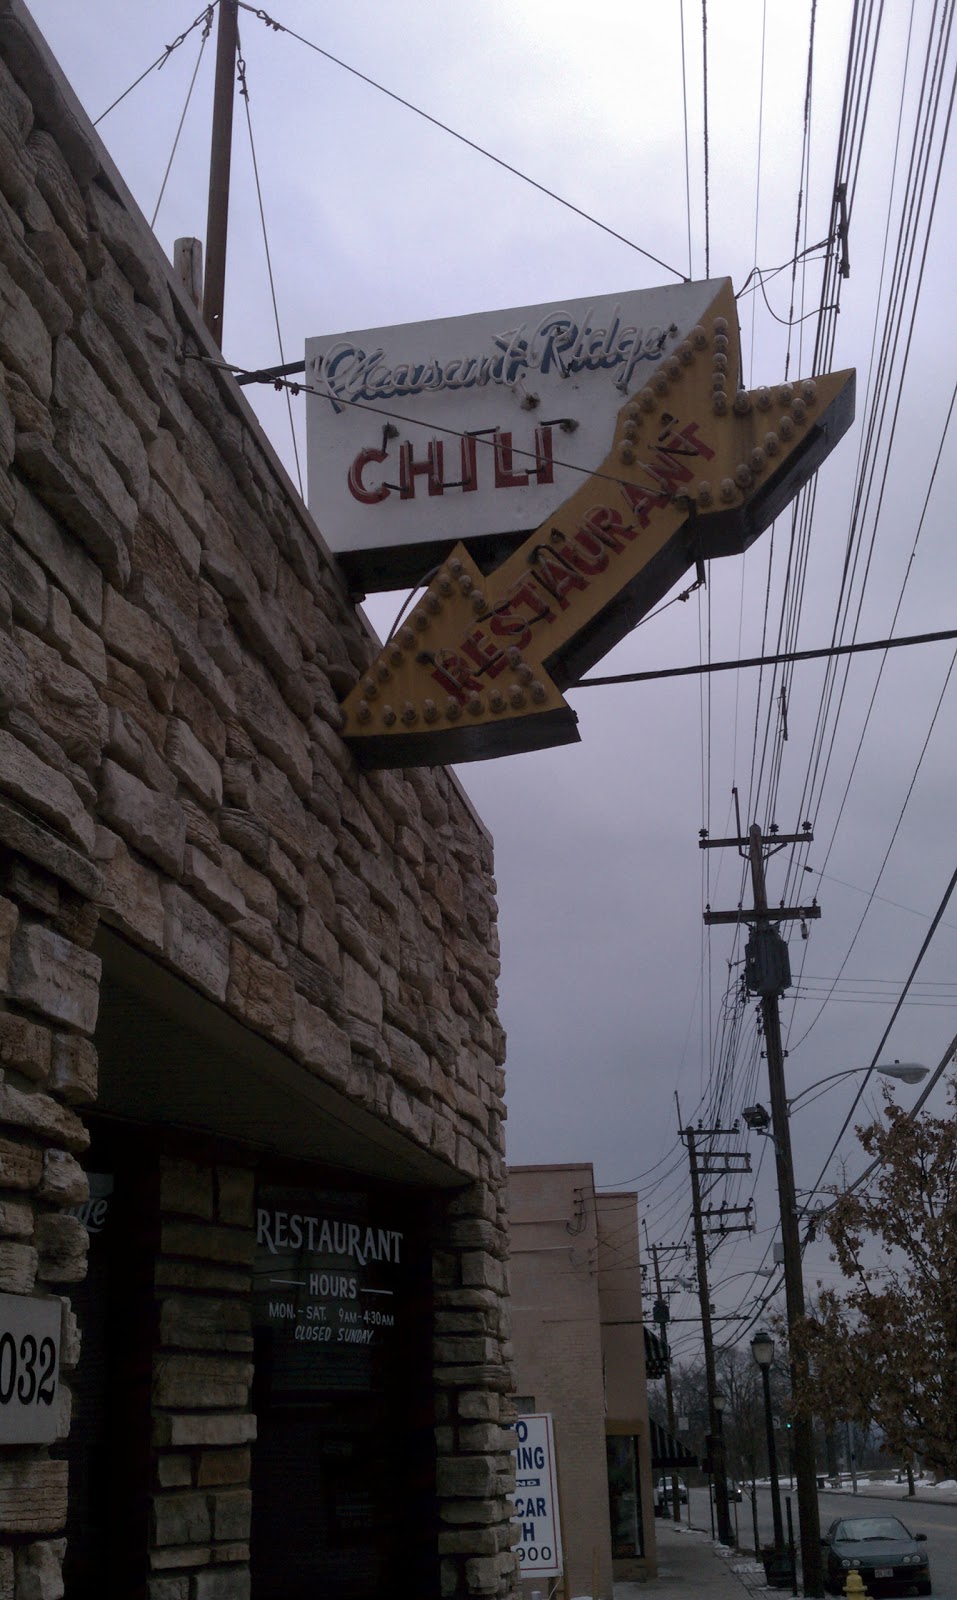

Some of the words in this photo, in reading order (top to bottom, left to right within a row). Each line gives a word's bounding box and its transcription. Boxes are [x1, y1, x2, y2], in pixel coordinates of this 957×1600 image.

[311, 322, 530, 413] Pleasant
[527, 304, 664, 395] Ridge
[348, 425, 555, 504] CHILI
[431, 422, 715, 704] RESTAURANT
[256, 1208, 404, 1266] RESTAURANT
[309, 1273, 357, 1299] HOURS
[294, 1325, 332, 1342] CLOSED
[337, 1328, 375, 1345] SUNDAY
[511, 1446, 545, 1470] ING
[514, 1497, 547, 1517] CAR
[522, 1522, 535, 1542] H
[516, 1546, 552, 1561] 900
